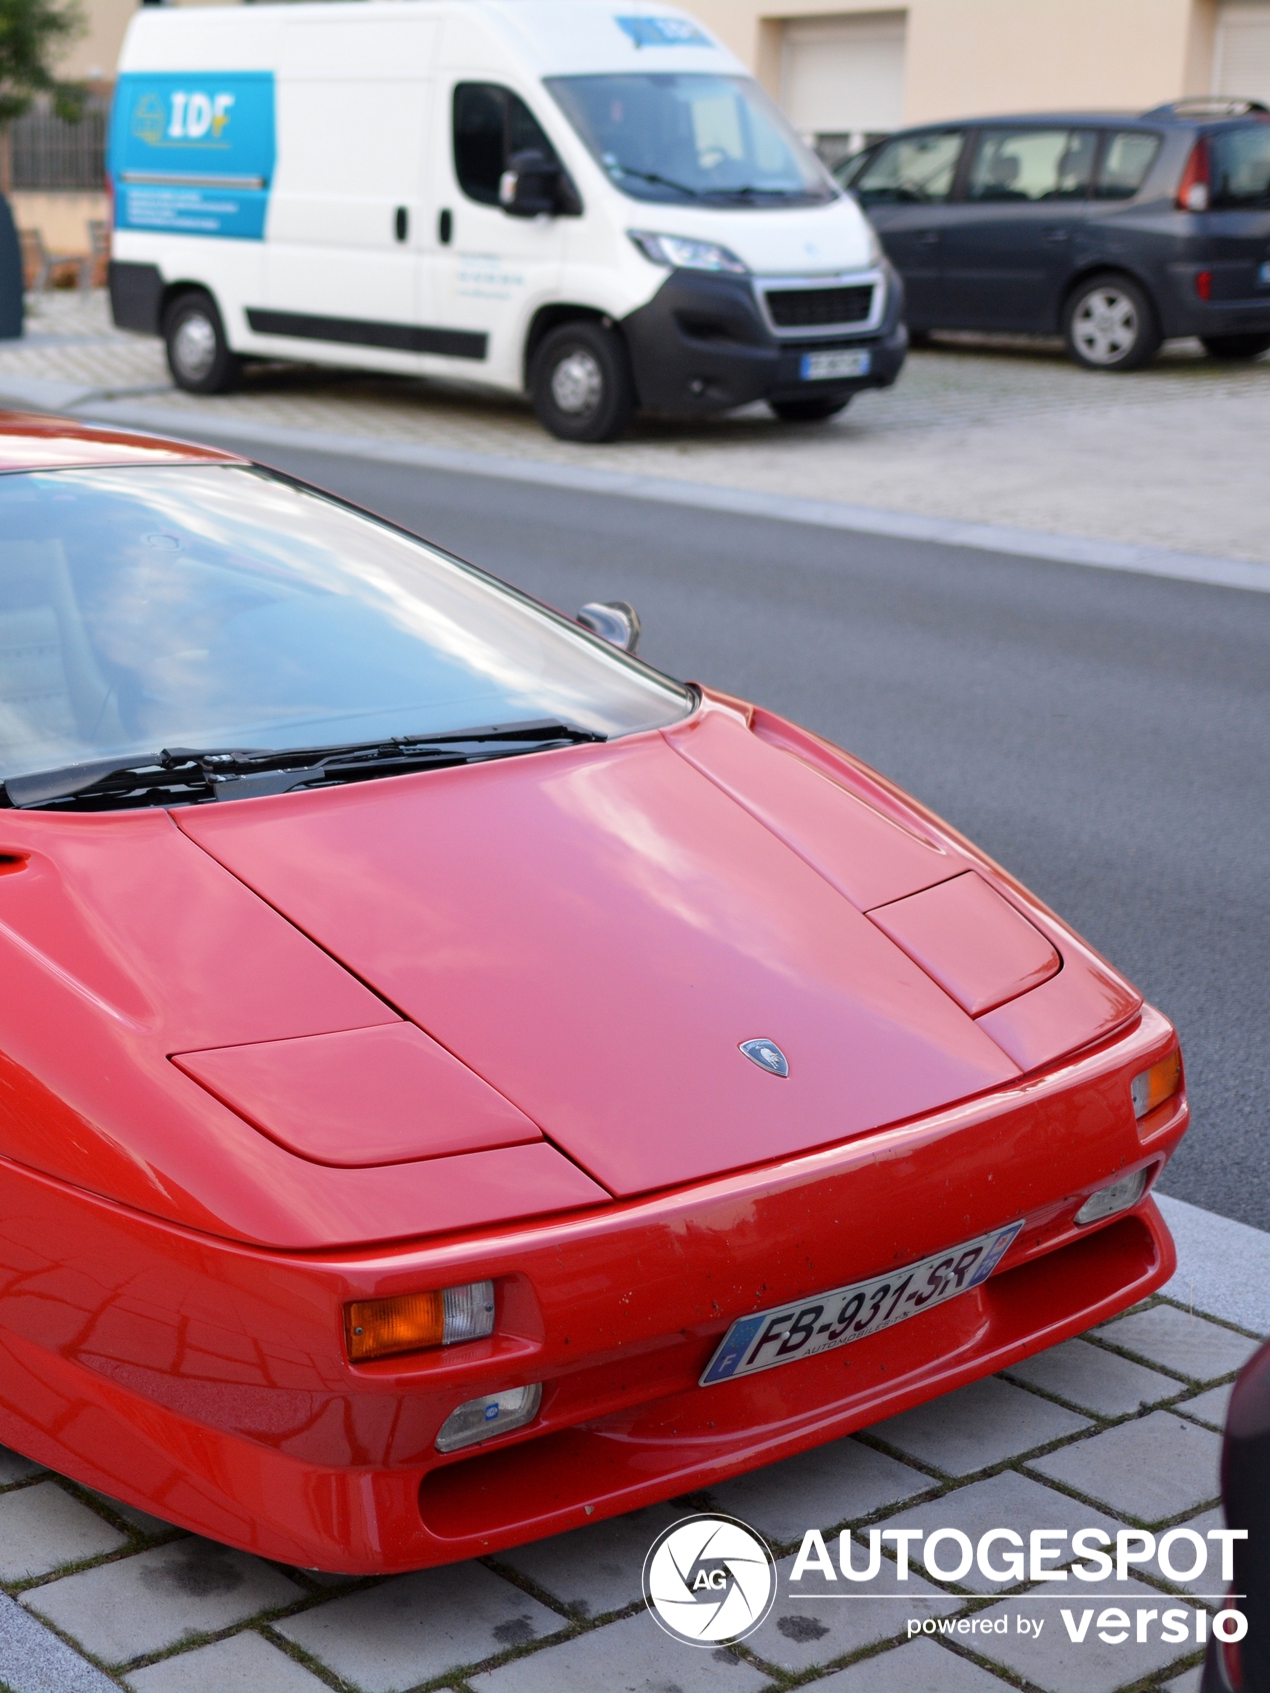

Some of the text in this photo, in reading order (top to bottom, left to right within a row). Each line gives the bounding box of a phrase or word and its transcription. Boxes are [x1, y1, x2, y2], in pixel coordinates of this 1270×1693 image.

[167, 91, 236, 139] IDF
[746, 1246, 984, 1366] FB-931-SR
[718, 1353, 737, 1372] F
